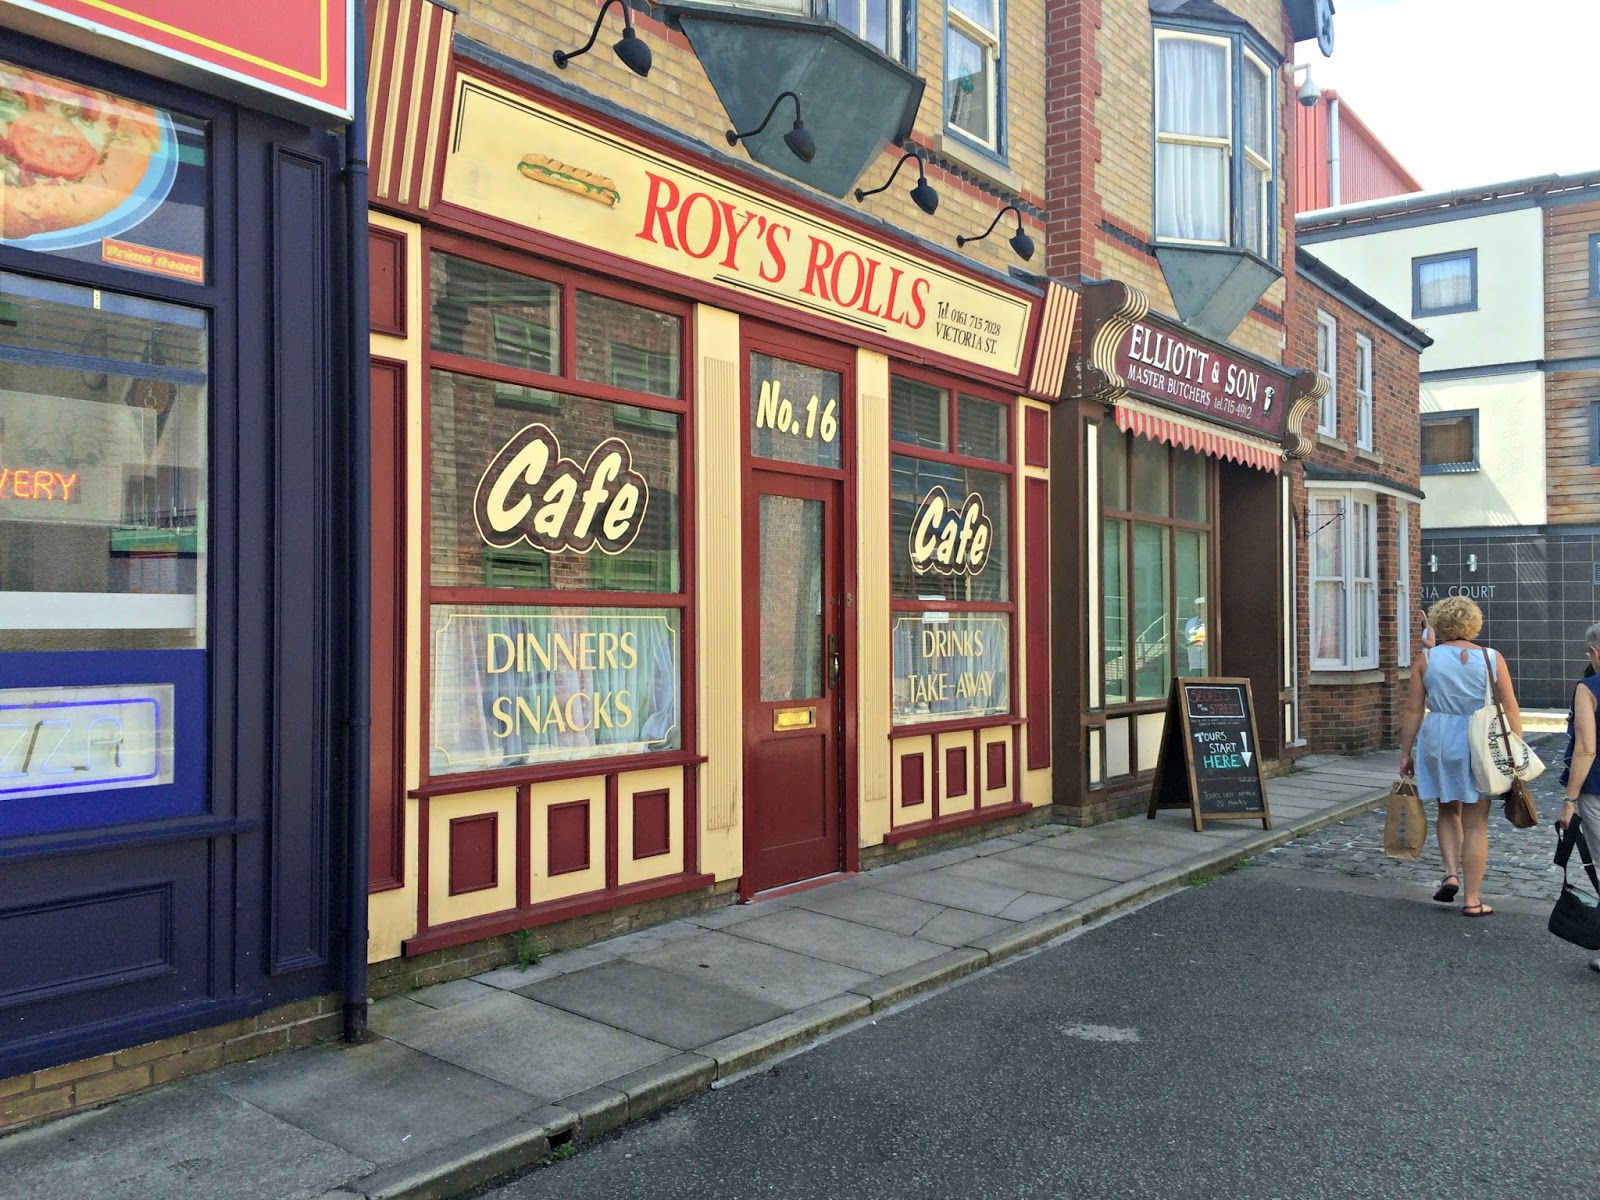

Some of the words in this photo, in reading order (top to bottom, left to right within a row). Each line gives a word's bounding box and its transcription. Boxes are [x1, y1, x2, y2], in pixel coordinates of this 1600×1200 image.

[105, 245, 153, 265] Prima
[635, 171, 791, 284] ROY'S
[799, 235, 930, 330] ROLLS
[937, 301, 950, 319] Tel
[951, 308, 968, 326] 0161
[969, 315, 983, 330] 715
[984, 320, 1001, 336] 7028
[936, 321, 982, 351] VICTORIA
[984, 337, 997, 354] ST.
[1128, 323, 1209, 385] ELLIOTT
[1211, 360, 1220, 384] &
[1225, 363, 1260, 405] SON
[1127, 364, 1164, 391] MASTER
[1167, 379, 1211, 407] BUTCHERS
[486, 438, 639, 540] Cafe
[914, 496, 988, 566] Cafe
[1448, 585, 1496, 599] COURT
[486, 631, 638, 675] DINNERS
[922, 629, 984, 659] DRINKS
[908, 670, 996, 703] TAKE-AWAY
[492, 689, 633, 739] SNACKS
[1210, 703, 1239, 715] STREET
[1194, 731, 1227, 742] TOURS
[1209, 742, 1237, 754] START
[1203, 754, 1241, 768] HERE
